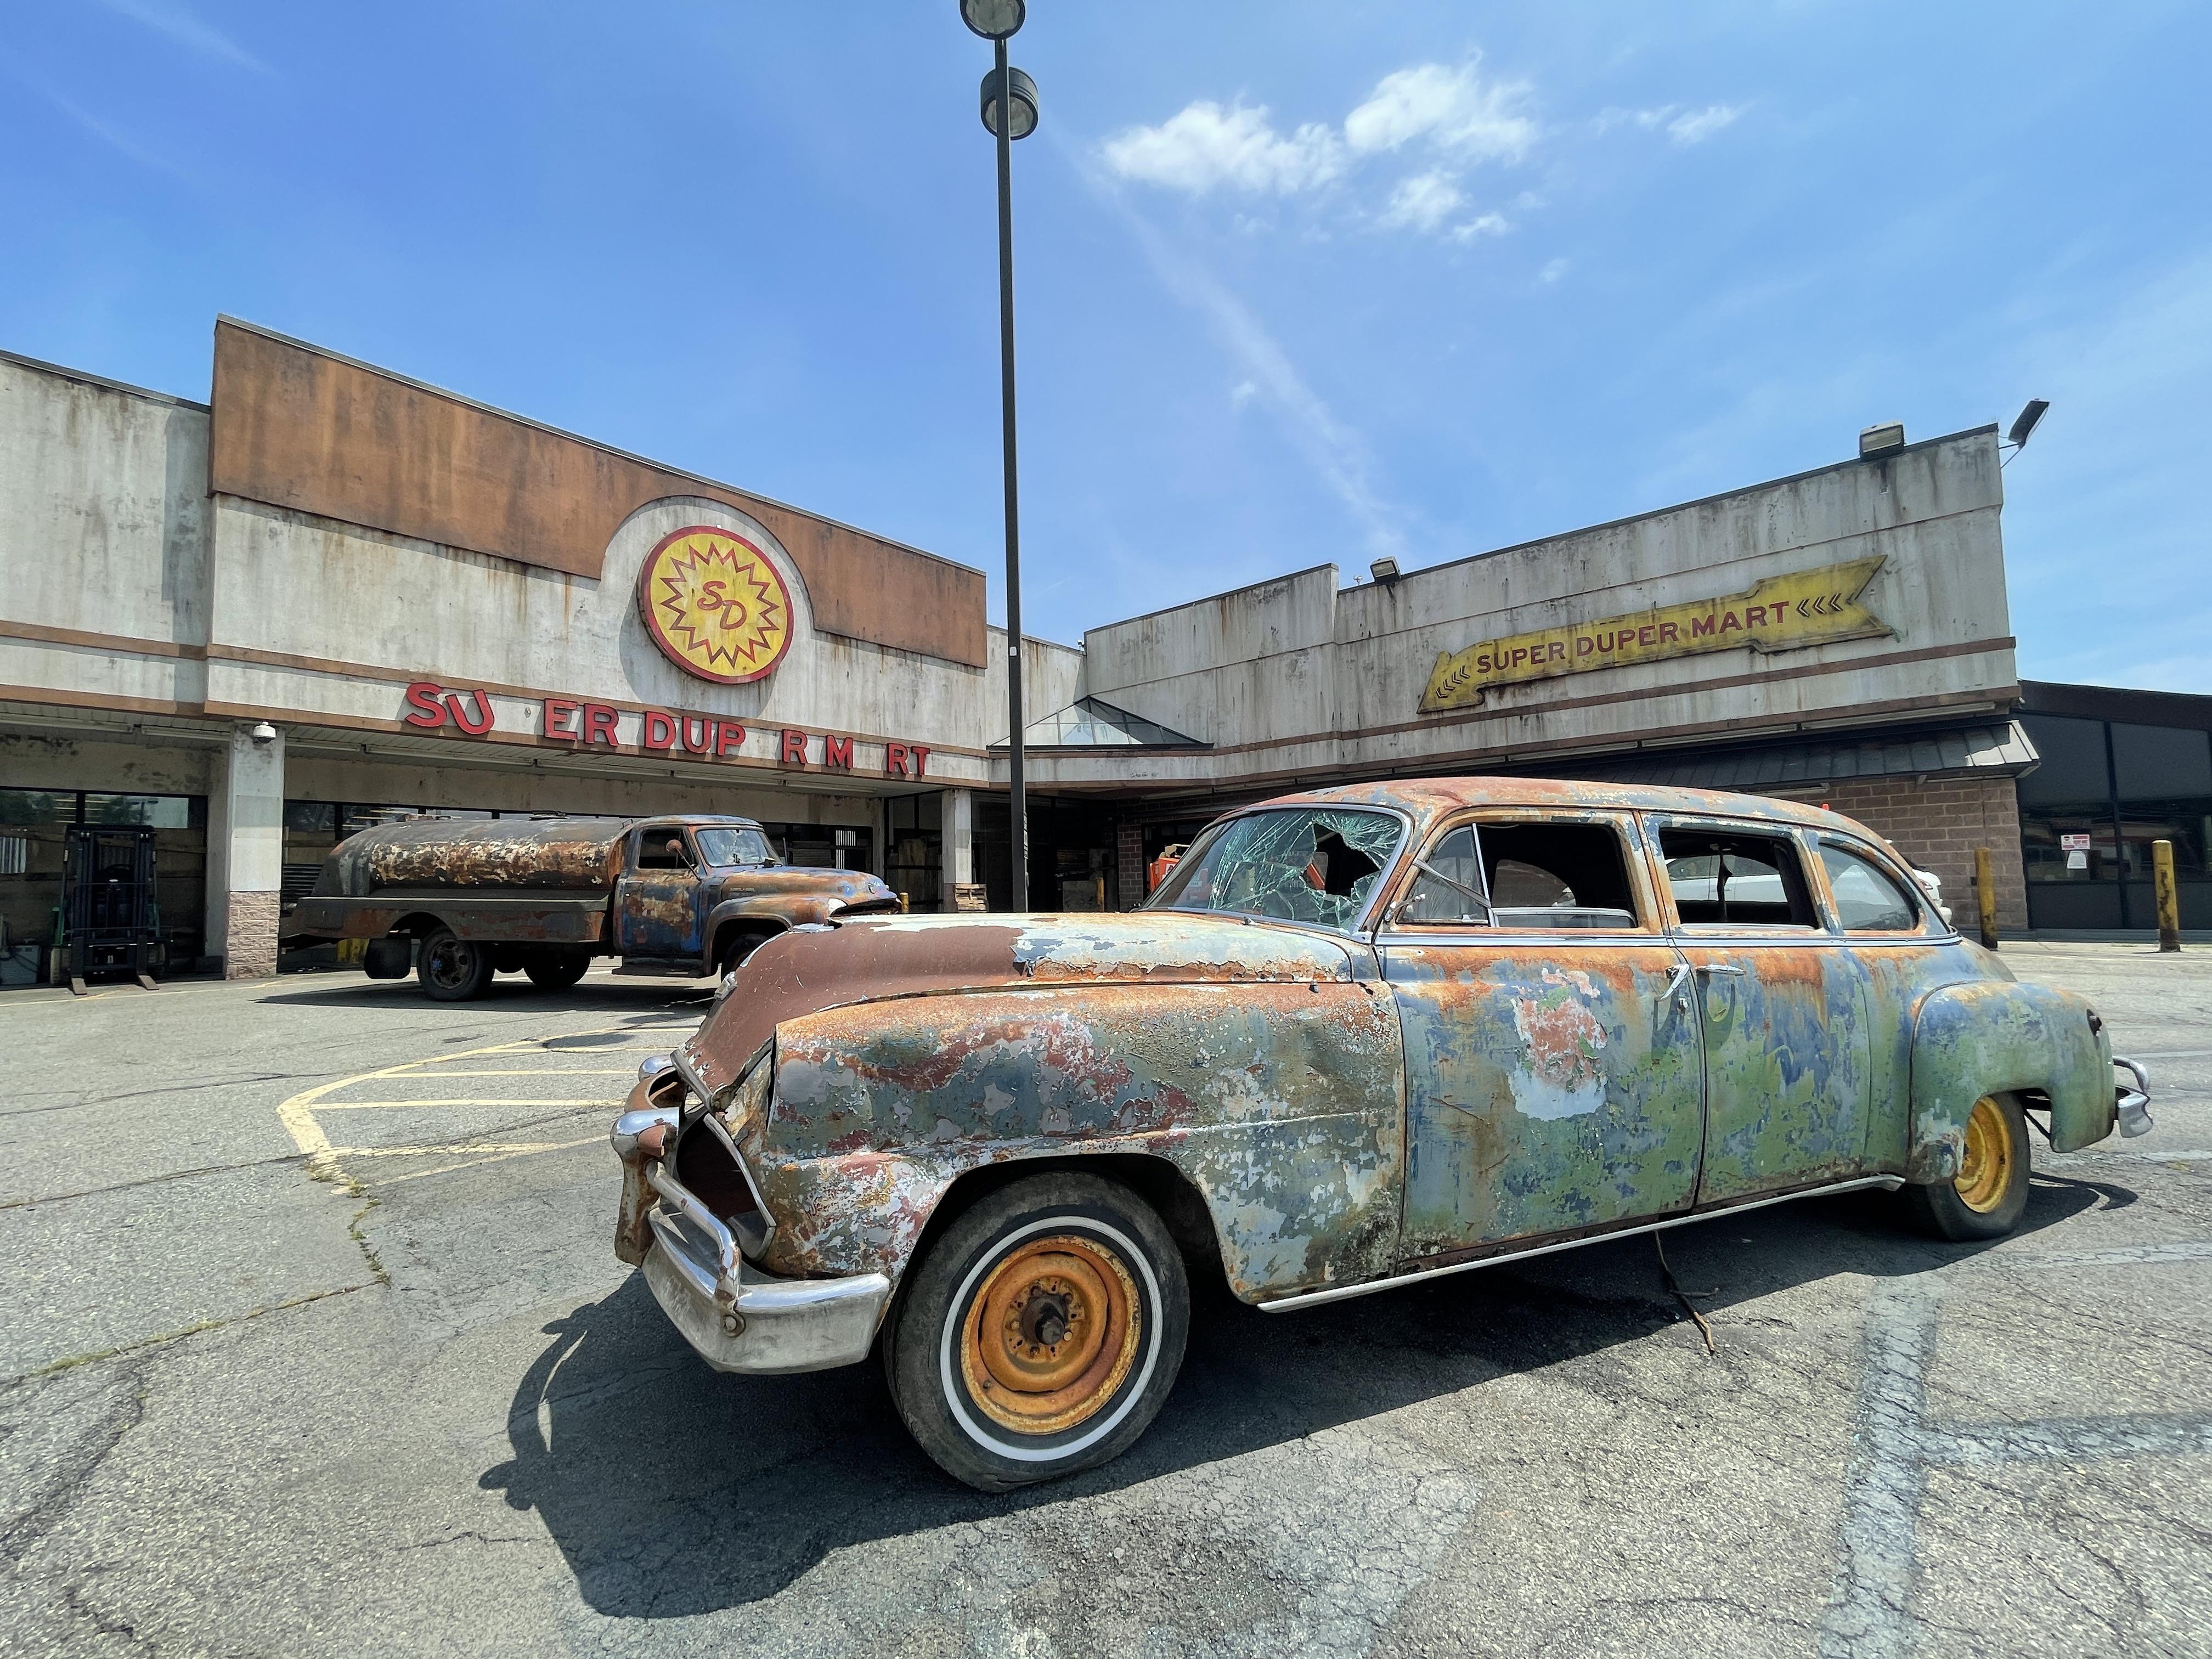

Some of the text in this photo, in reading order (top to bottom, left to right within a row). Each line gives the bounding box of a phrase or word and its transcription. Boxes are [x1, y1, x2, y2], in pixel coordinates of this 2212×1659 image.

[1477, 601, 1790, 674] SUPER DUPER MART
